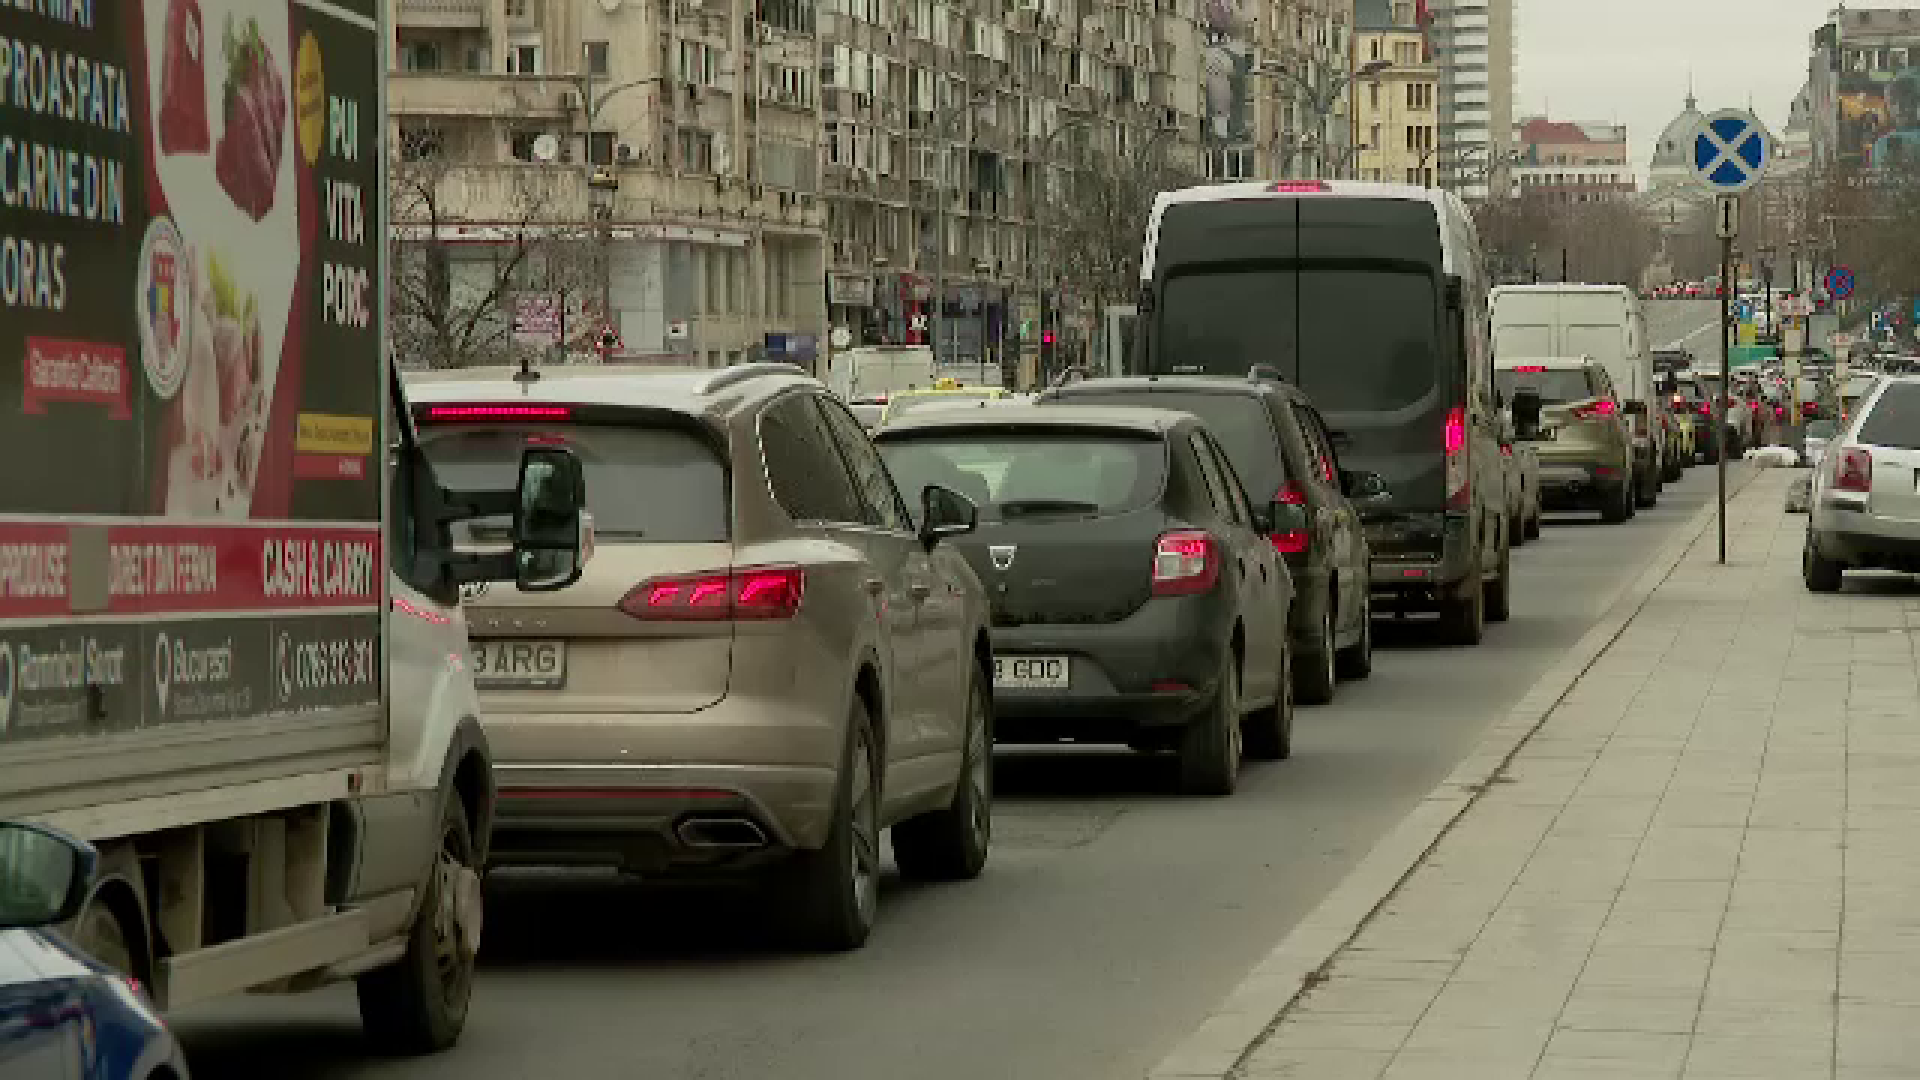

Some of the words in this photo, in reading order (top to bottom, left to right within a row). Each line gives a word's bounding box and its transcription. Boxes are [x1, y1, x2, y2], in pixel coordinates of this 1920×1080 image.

[0, 36, 131, 132] PROASPATA
[330, 95, 358, 162] PUI
[0, 135, 80, 217] CARNE
[83, 153, 124, 225] DIN
[325, 178, 366, 246] VITA
[2, 235, 67, 312] ORAS
[323, 262, 370, 329] PORC
[263, 537, 307, 597] CASH
[309, 537, 321, 597] &
[323, 538, 373, 597] CARRY
[494, 642, 556, 673] ARG
